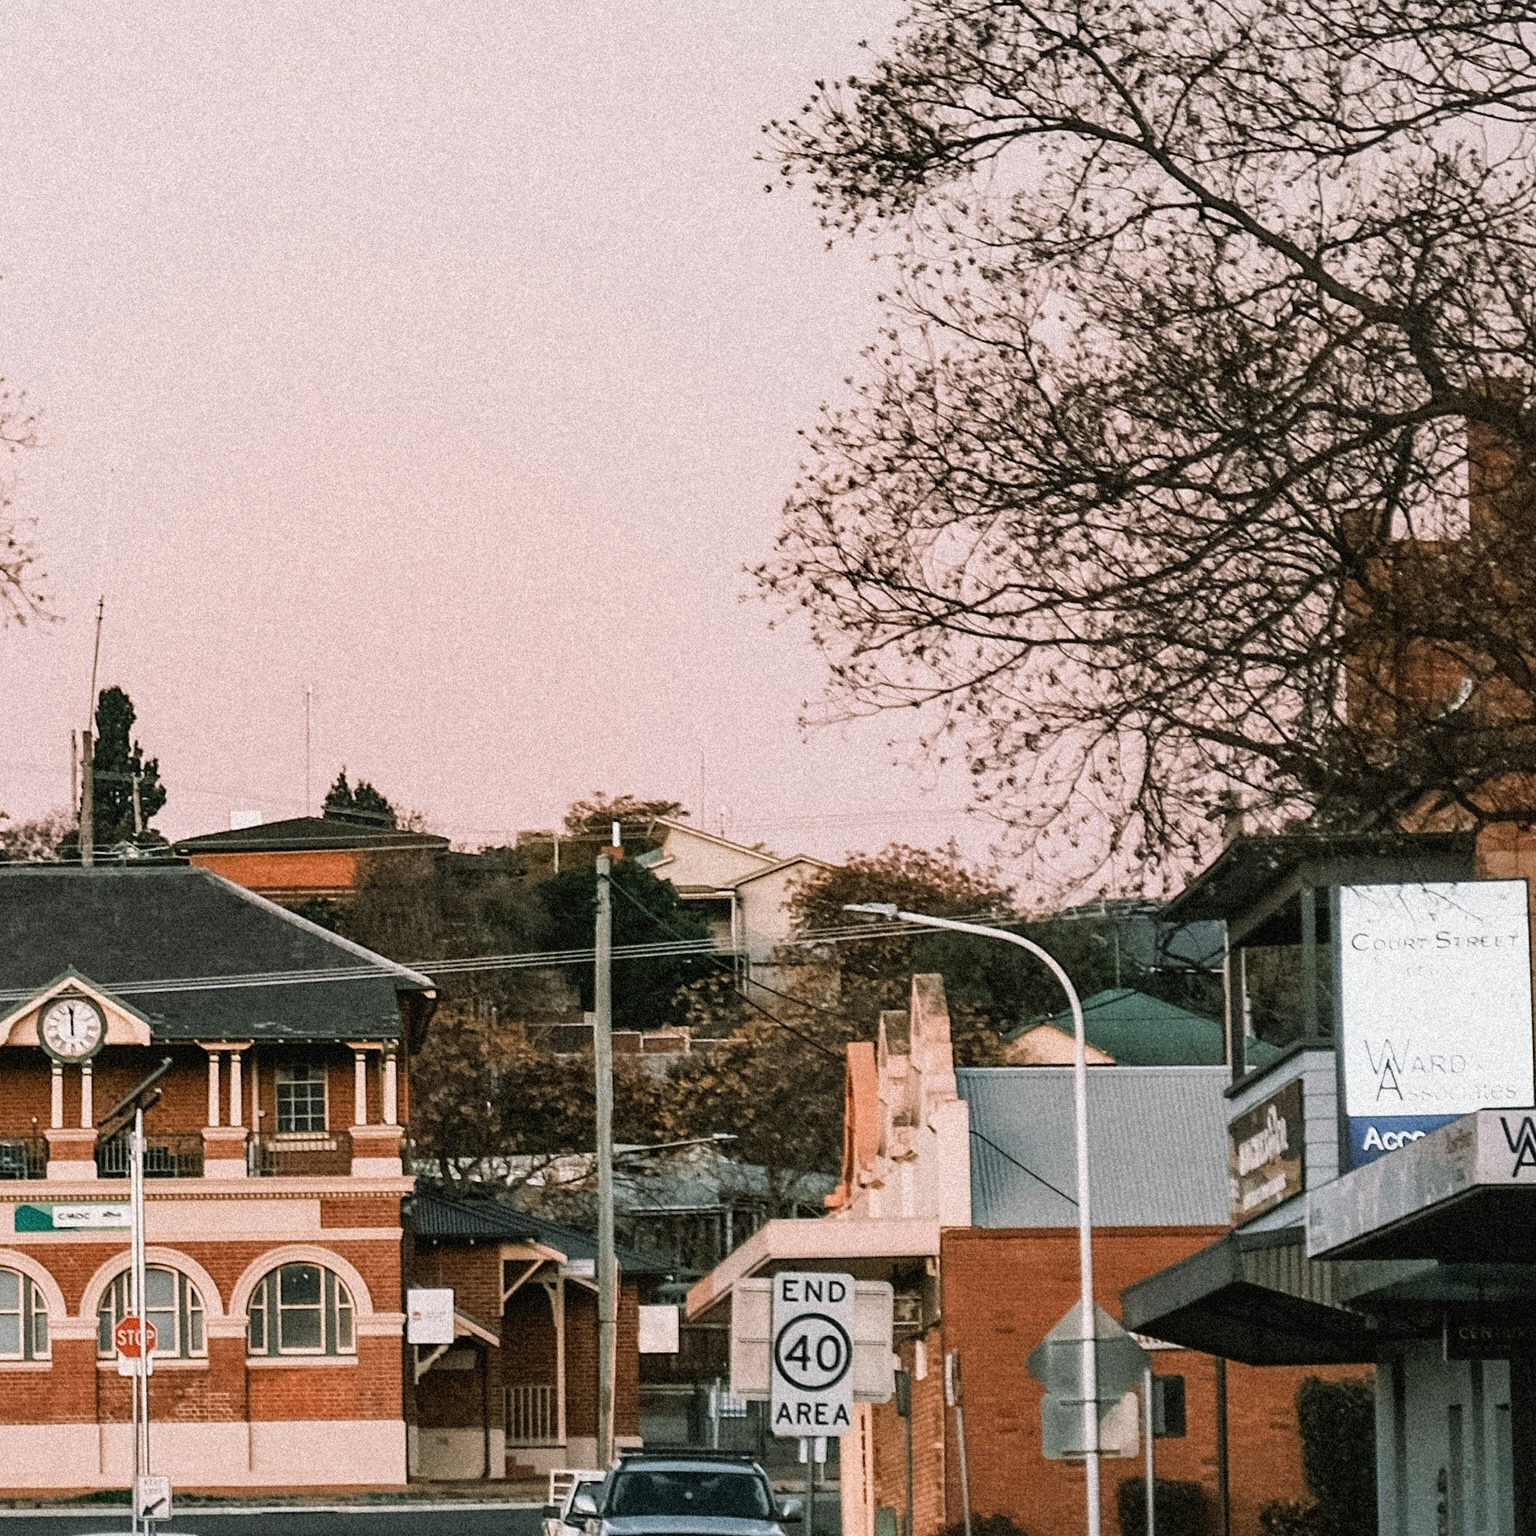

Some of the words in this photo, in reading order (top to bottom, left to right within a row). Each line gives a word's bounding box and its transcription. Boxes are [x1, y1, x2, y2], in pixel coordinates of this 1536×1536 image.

[1350, 931, 1428, 952] COURT
[1435, 929, 1520, 950] STREET
[1363, 1038, 1467, 1076] WARD
[1362, 1126, 1426, 1151] Acc
[782, 1279, 846, 1304] END
[783, 1334, 843, 1373] 40
[775, 1402, 851, 1427] AREA
